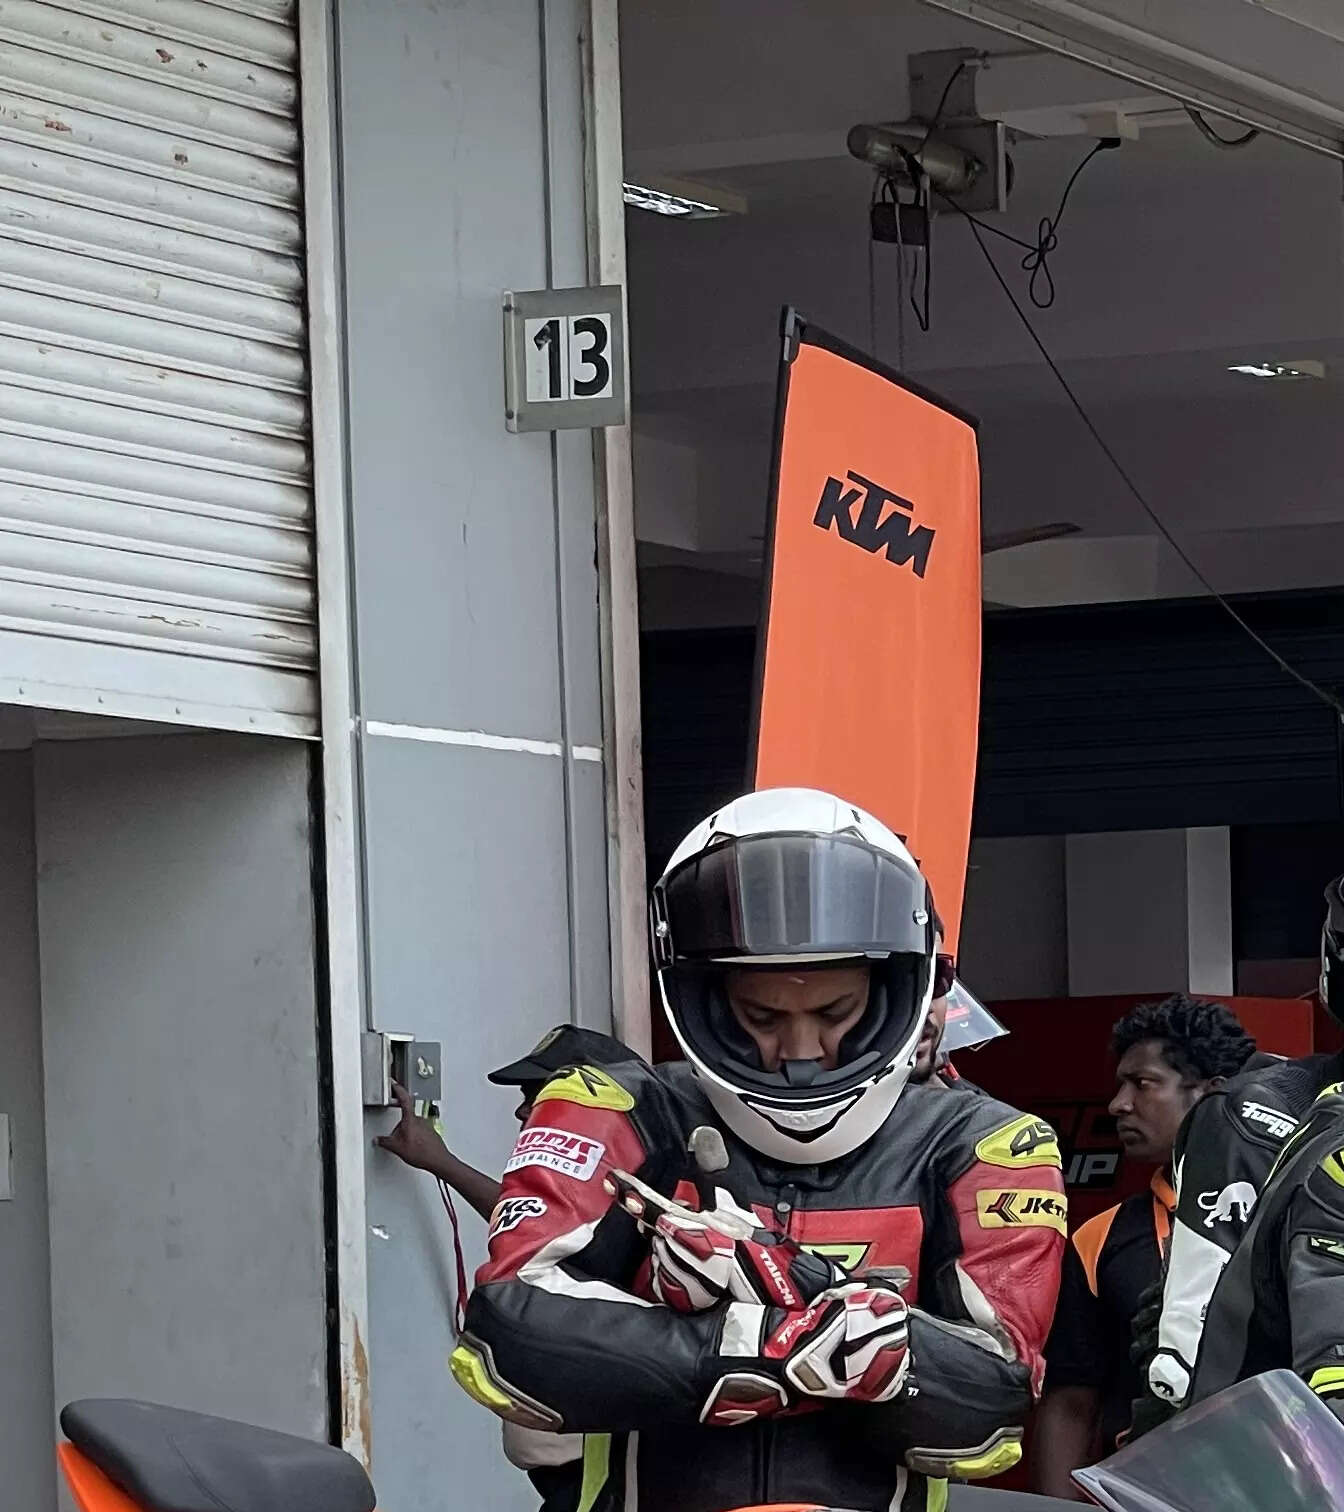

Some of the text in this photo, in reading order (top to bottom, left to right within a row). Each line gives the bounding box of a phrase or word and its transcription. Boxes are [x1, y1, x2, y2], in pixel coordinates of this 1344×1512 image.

[532, 317, 610, 400] 13
[812, 470, 936, 579] KTM
[760, 1249, 796, 1306] TAICHI
